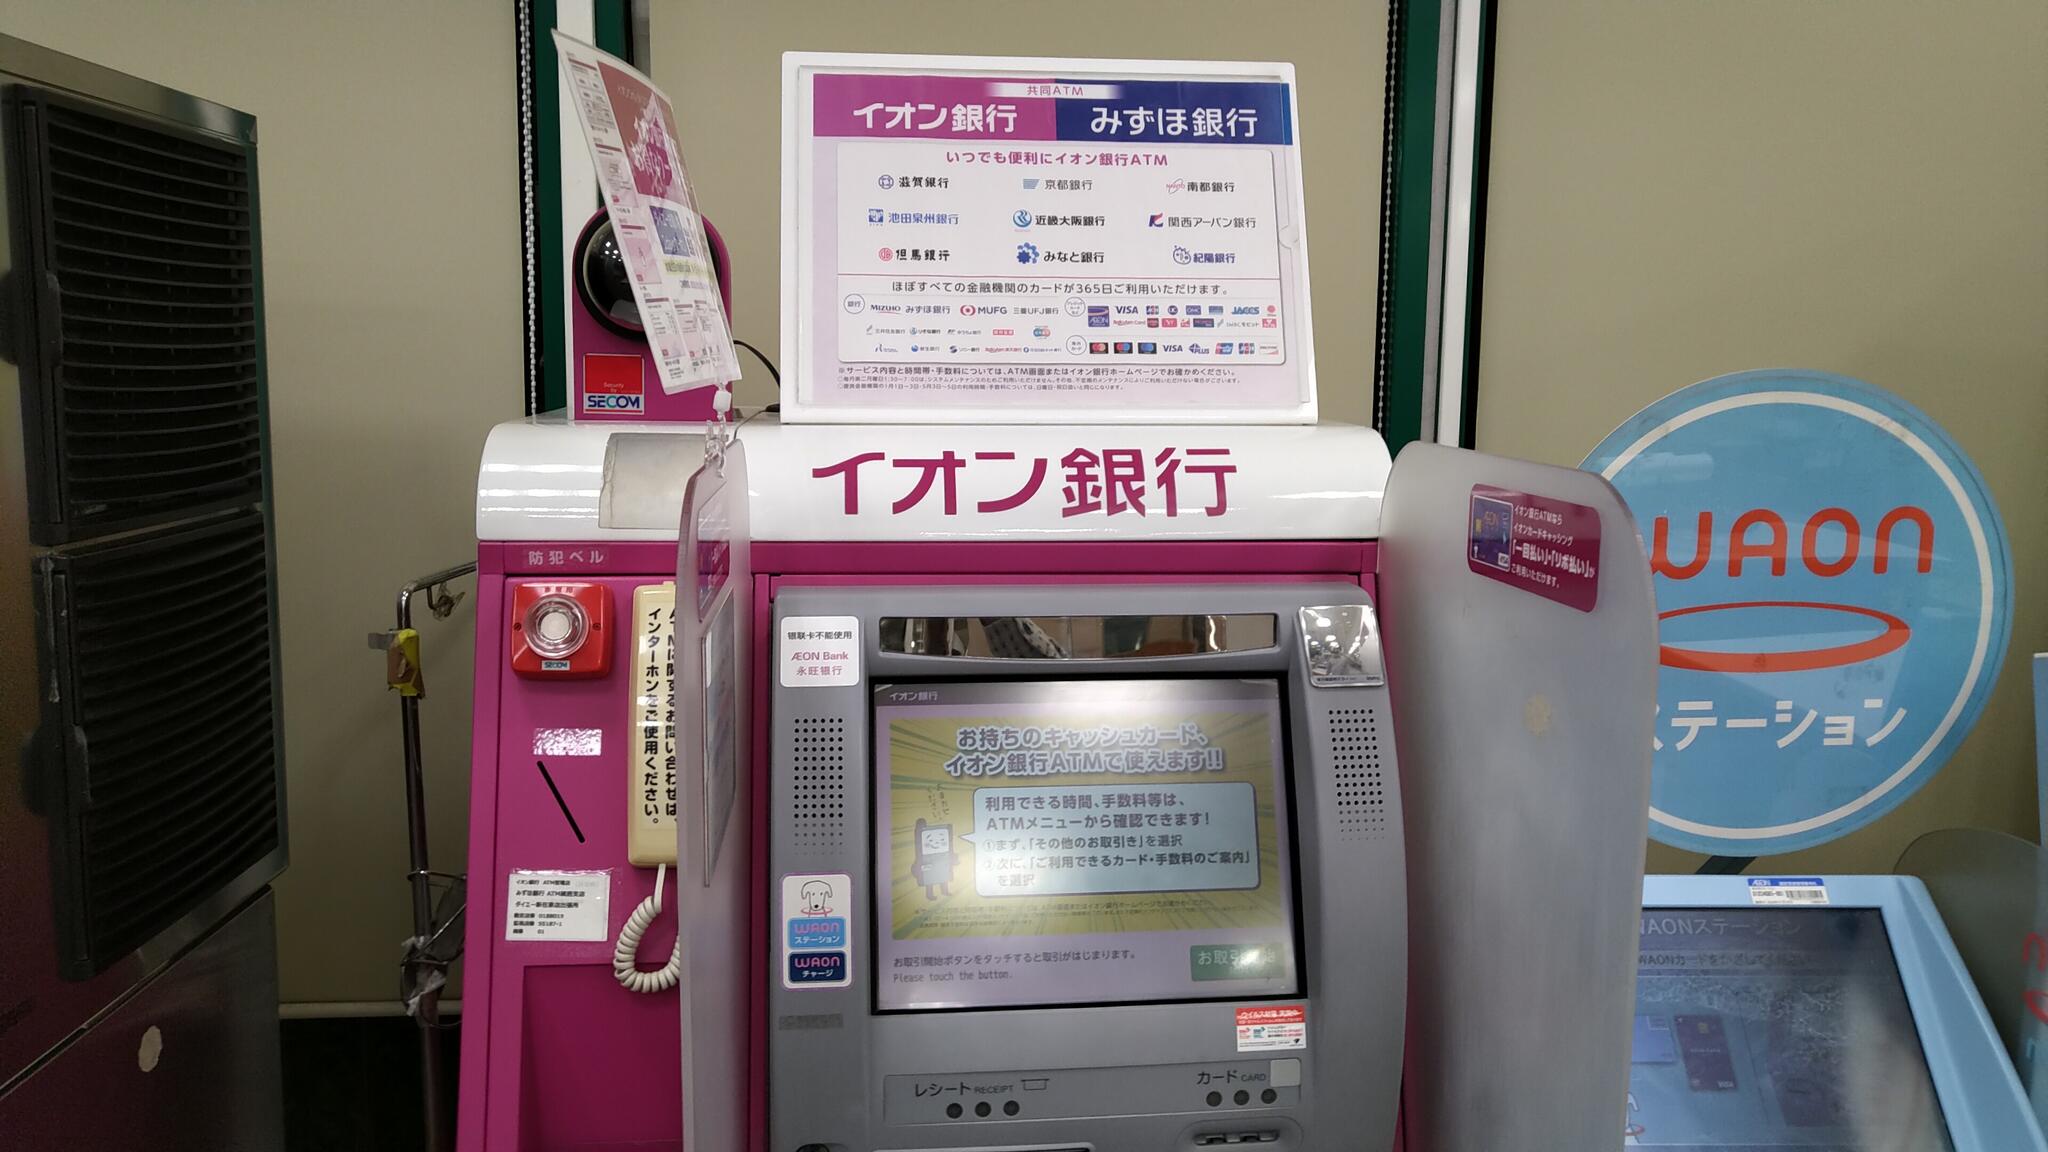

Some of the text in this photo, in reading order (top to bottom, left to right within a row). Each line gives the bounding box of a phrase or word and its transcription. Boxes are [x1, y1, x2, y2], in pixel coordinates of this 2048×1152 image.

[1026, 84, 1085, 97] 共同ATM
[852, 102, 1018, 134] イオン銀行
[1090, 105, 1259, 138] みずほ銀行
[946, 150, 1168, 167] いつでも便利にイオン銀行ATM
[898, 176, 949, 189] 滋賀銀行
[1044, 179, 1093, 191] 京都銀行
[1187, 181, 1235, 193] 南都銀行
[888, 212, 960, 225] 池田泉州銀行
[1034, 215, 1105, 227] 近畿大阪銀行
[1167, 216, 1257, 229] 関西アーバン銀行
[896, 248, 951, 262] 但馬銀行
[1043, 251, 1105, 264] みなと銀行
[1193, 252, 1236, 265] 紀陽銀行
[891, 281, 1228, 297] ほぼすべての金融機関のカードが365日ご利用いただけます。
[905, 305, 951, 315] みずほ銀行
[978, 306, 1008, 315] MUFG
[1013, 307, 1059, 316] 三菱UFJ銀行
[1115, 306, 1139, 315] VISA
[1231, 306, 1260, 315] JACCS
[1163, 344, 1183, 353] VISA
[587, 395, 640, 409] SECOM
[812, 446, 1238, 519] イオン銀行
[1514, 504, 1563, 526] イオン銀行ATMなら
[1513, 522, 1574, 548] イオンカードキャッシング
[528, 550, 605, 566] 防犯ベル
[1511, 563, 1560, 589] ご利用いただけます。
[822, 650, 849, 661] Bank
[544, 661, 568, 670] SECOM
[796, 665, 843, 677] 永旺银行
[889, 691, 939, 702] イオン銀行
[643, 607, 663, 824] インターホンをご使用ください。
[956, 723, 1208, 751] お持ちのキャッシュカード、
[984, 793, 1187, 812] 利用できる時間、手数料等は、
[997, 873, 1036, 888] を選択
[794, 922, 840, 934] WAON
[794, 935, 841, 945] ステーション
[794, 956, 841, 969] WAON
[893, 949, 1136, 968] お取引開始ボタンをタッチすると取引がはじまります。
[801, 968, 834, 979] チャージ
[893, 969, 1013, 985] Please touch the button.
[1195, 1069, 1266, 1086] カード CARD
[914, 1081, 1014, 1098] レシート RECEIPT
